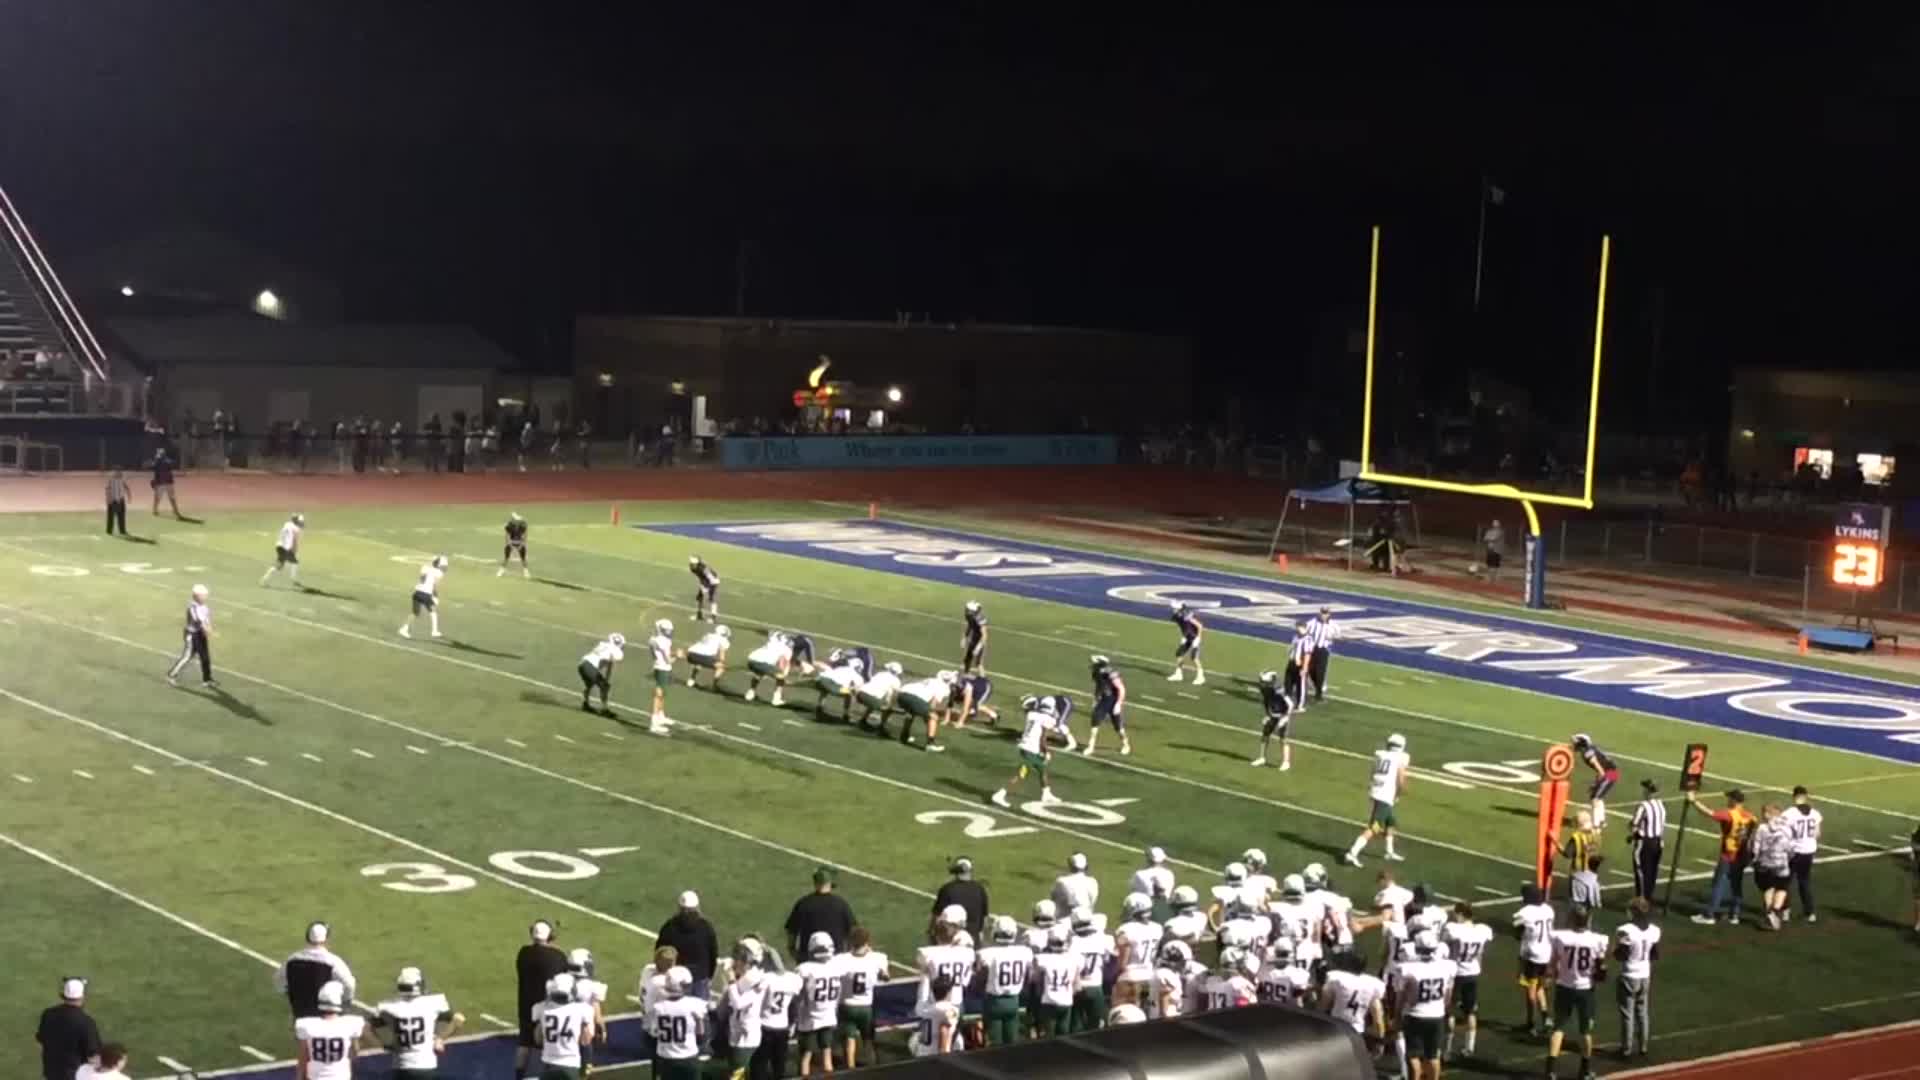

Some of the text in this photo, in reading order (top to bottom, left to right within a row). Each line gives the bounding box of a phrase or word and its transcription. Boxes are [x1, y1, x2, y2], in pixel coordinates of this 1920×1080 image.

[1835, 525, 1879, 540] LYKINS
[714, 521, 1143, 577] WEST
[1832, 543, 1879, 587] 23
[1105, 583, 1920, 744] CLERMO
[1687, 749, 1705, 775] 2
[360, 850, 601, 893] 30
[1564, 946, 1591, 971] 78
[999, 960, 1024, 987] 60
[814, 976, 841, 1002] 26
[1418, 978, 1444, 1002] 63
[544, 1014, 574, 1044] 24
[657, 1015, 688, 1044] 50
[311, 1036, 345, 1064] 89
